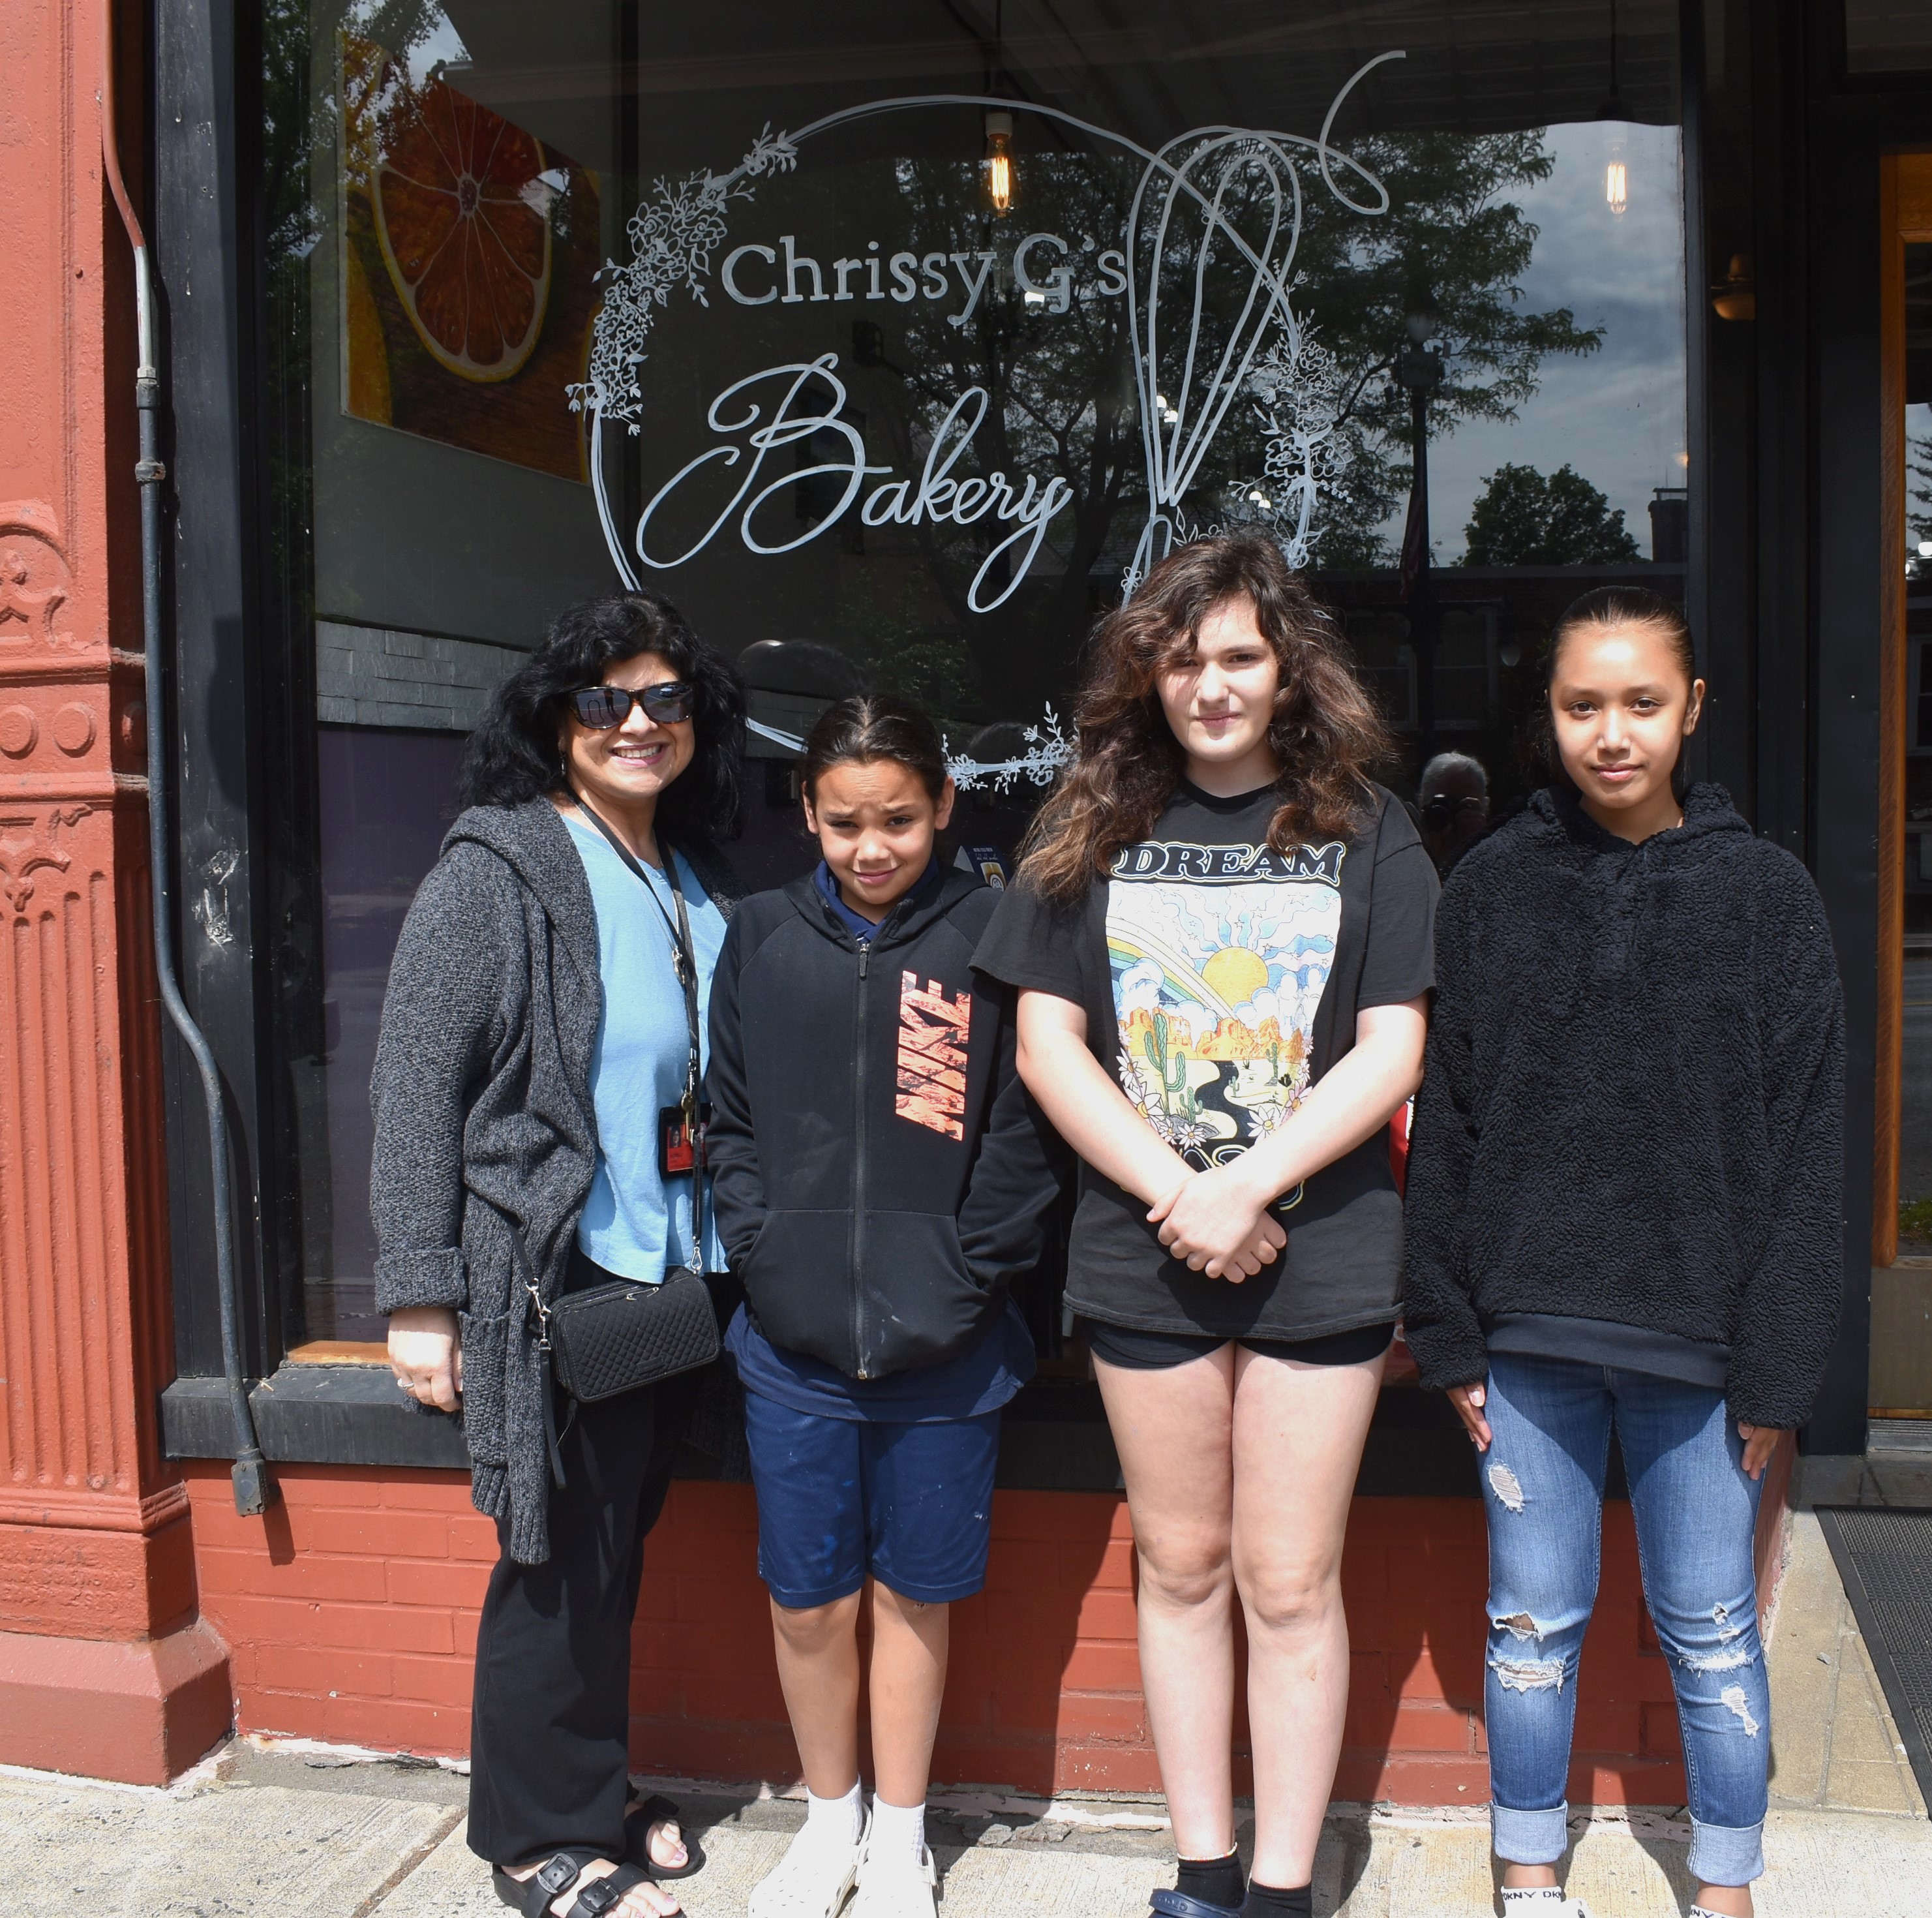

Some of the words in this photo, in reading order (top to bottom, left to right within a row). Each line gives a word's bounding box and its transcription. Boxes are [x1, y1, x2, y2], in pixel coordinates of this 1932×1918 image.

[721, 236, 997, 326] Chrissy
[1013, 232, 1128, 313] G's
[636, 352, 1075, 613] Bakery
[1111, 841, 1346, 887] DREAM
[896, 970, 971, 1142] NIKE
[1503, 1891, 1536, 1900] DKNY
